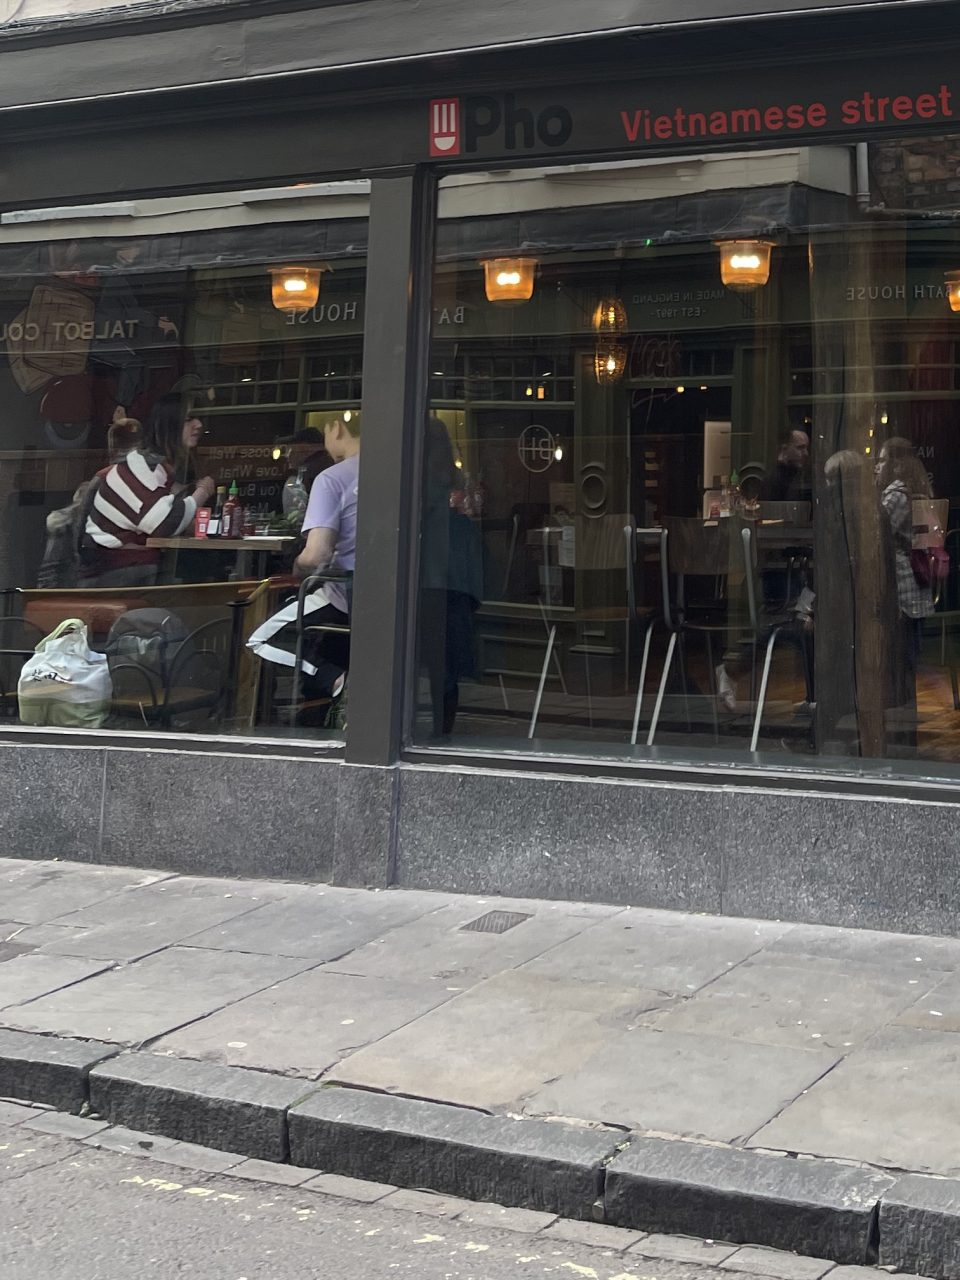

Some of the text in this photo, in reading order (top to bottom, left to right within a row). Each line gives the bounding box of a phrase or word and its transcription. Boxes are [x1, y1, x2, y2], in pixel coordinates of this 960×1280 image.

[464, 93, 573, 153] Pho
[620, 103, 827, 142] Vietnamese
[841, 87, 953, 124] street
